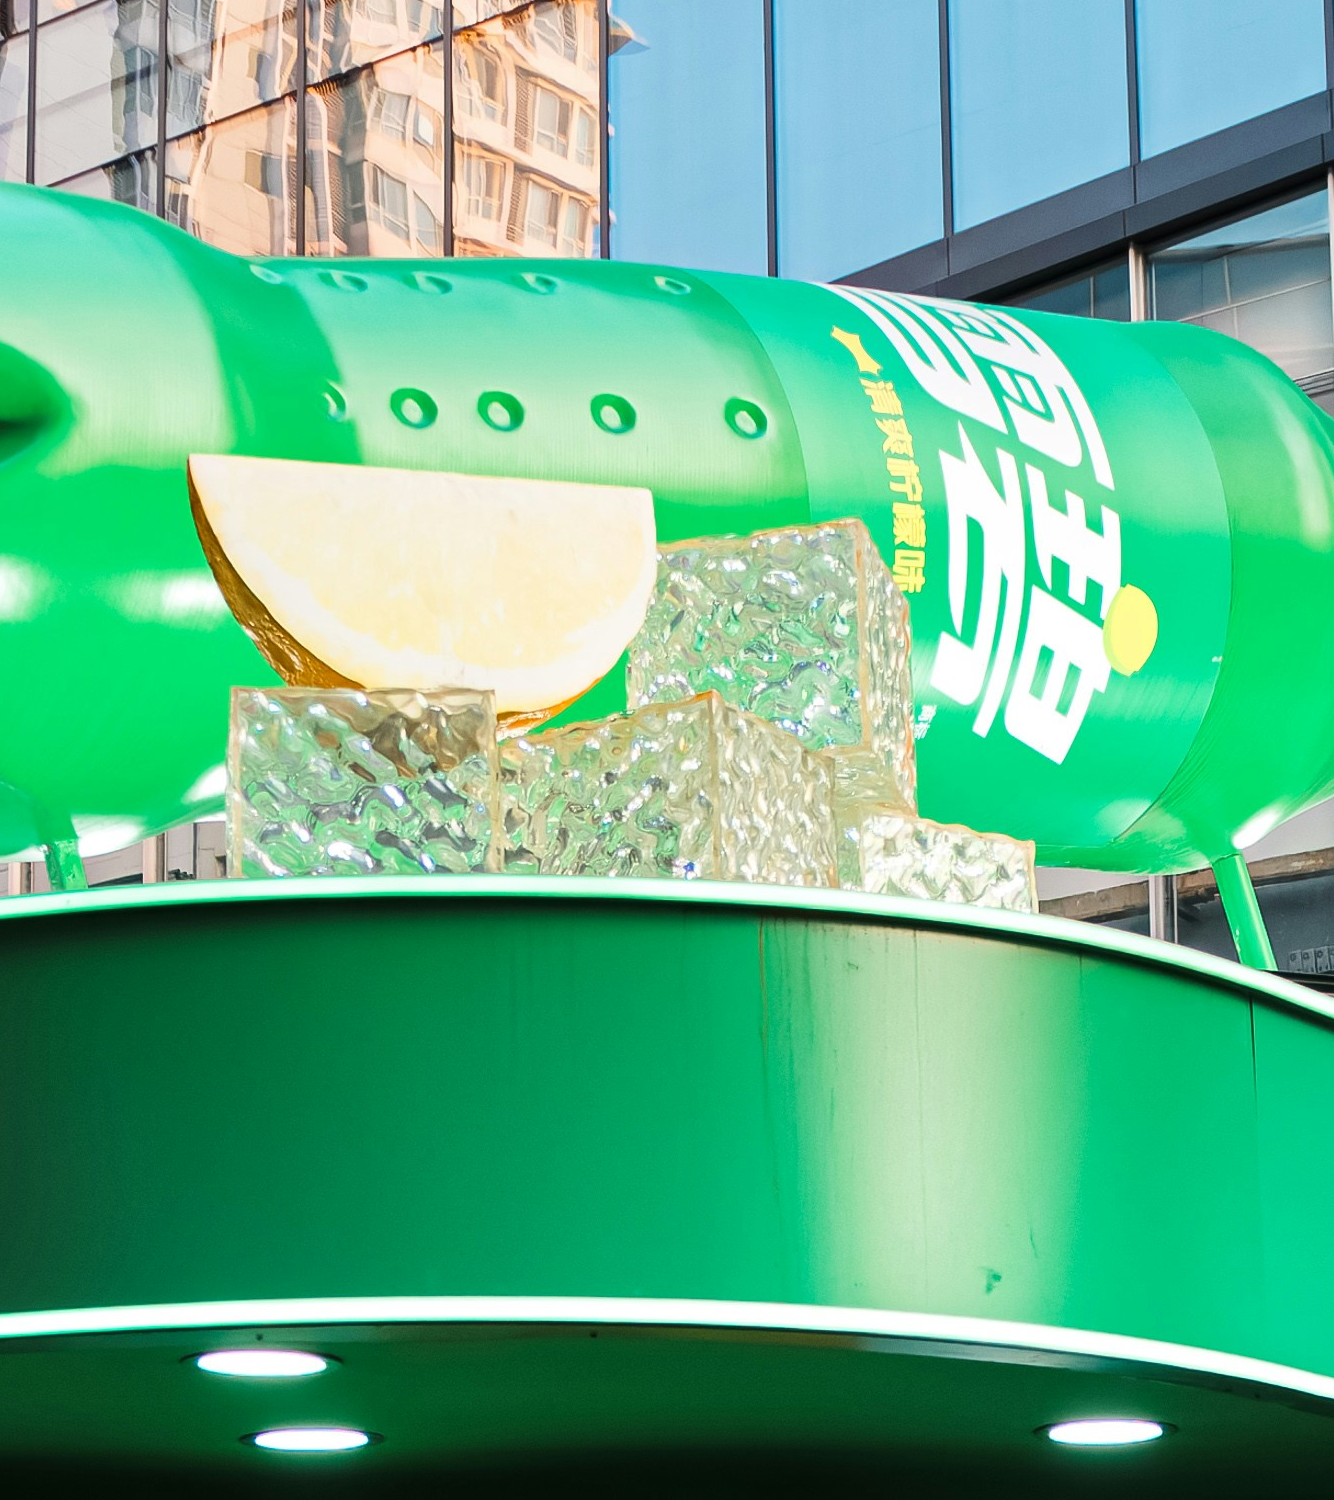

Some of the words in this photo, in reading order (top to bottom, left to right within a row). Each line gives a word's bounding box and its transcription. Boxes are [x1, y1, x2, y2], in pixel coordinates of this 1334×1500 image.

[817, 282, 1123, 766] 雪碧
[860, 378, 927, 594] 清爽柠檬味
